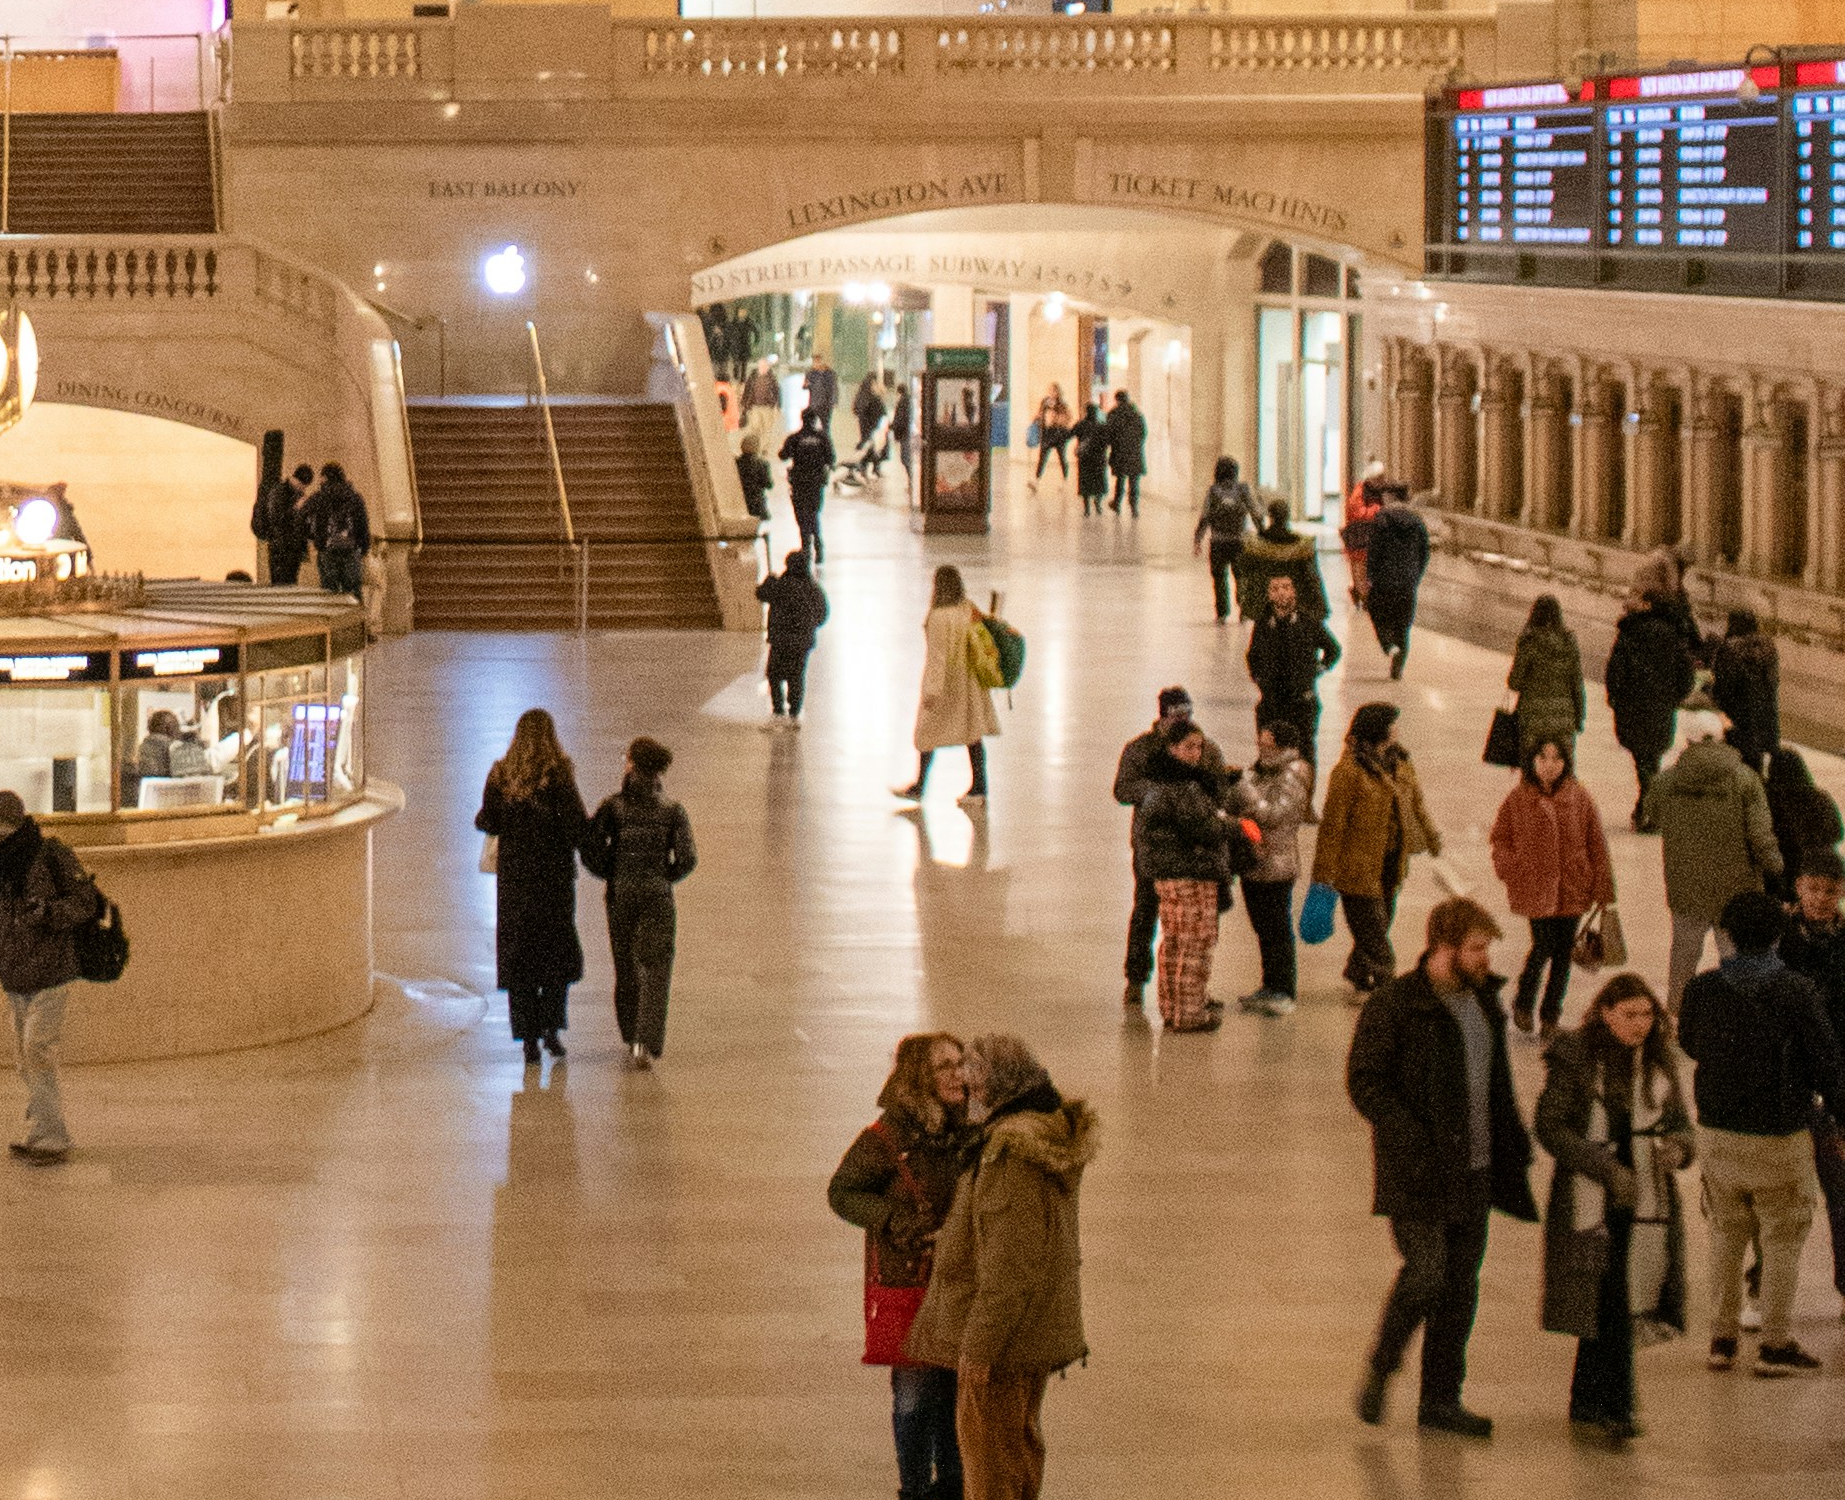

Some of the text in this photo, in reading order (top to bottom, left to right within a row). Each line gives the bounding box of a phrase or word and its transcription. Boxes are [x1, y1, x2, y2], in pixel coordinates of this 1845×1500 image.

[428, 180, 582, 198] EAST BALCONY
[786, 173, 1008, 229] LEXINGTON AVE
[1109, 173, 1349, 232] TICKET MACHINES
[728, 259, 815, 288] STREET
[819, 255, 917, 277] PASSAGE
[929, 255, 1026, 279] SUBWAY
